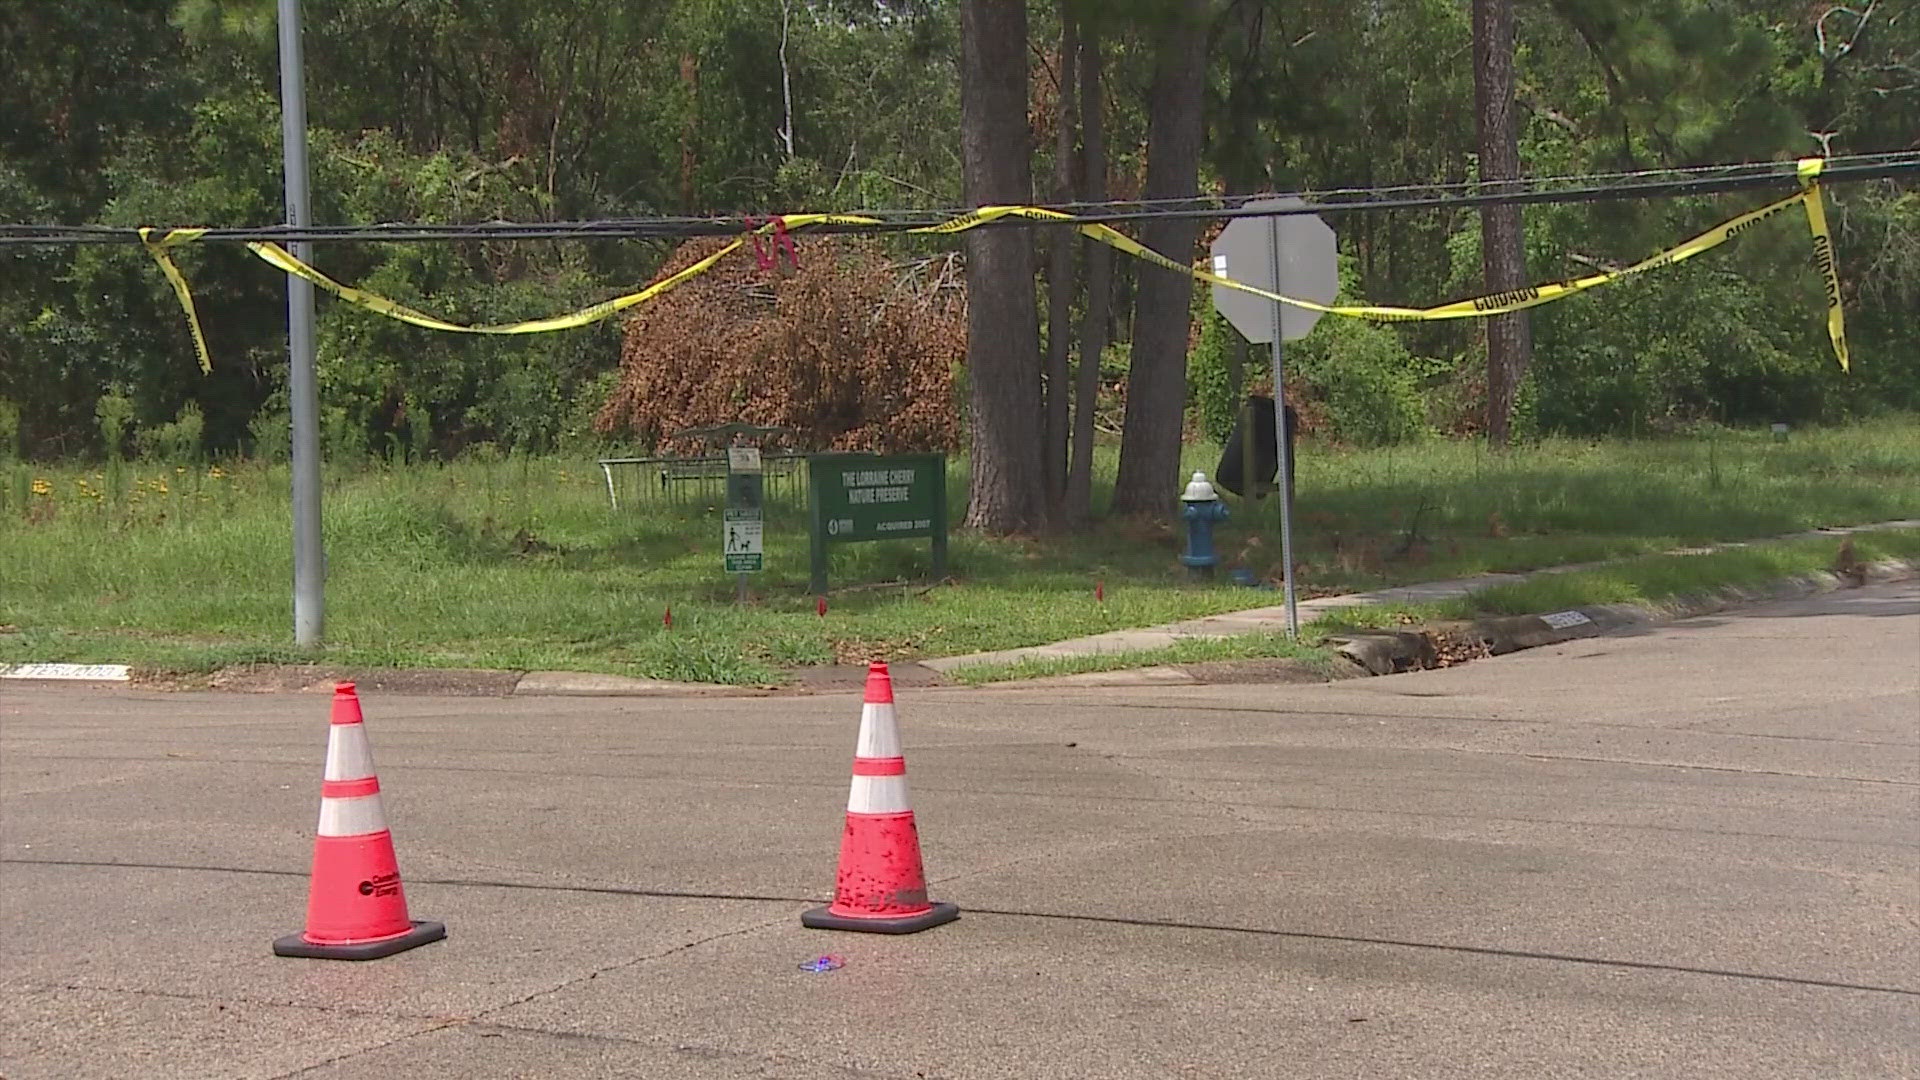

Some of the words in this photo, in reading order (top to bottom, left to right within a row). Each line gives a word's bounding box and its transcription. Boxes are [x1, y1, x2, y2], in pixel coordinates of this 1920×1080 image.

[1474, 287, 1539, 311] CUIDADO
[842, 471, 856, 487] THE
[857, 470, 888, 486] LORRAINE
[889, 469, 915, 485] CHERRY
[849, 488, 875, 504] NATURE
[876, 486, 909, 503] PRESERVE
[876, 520, 913, 532] ACQUIRED
